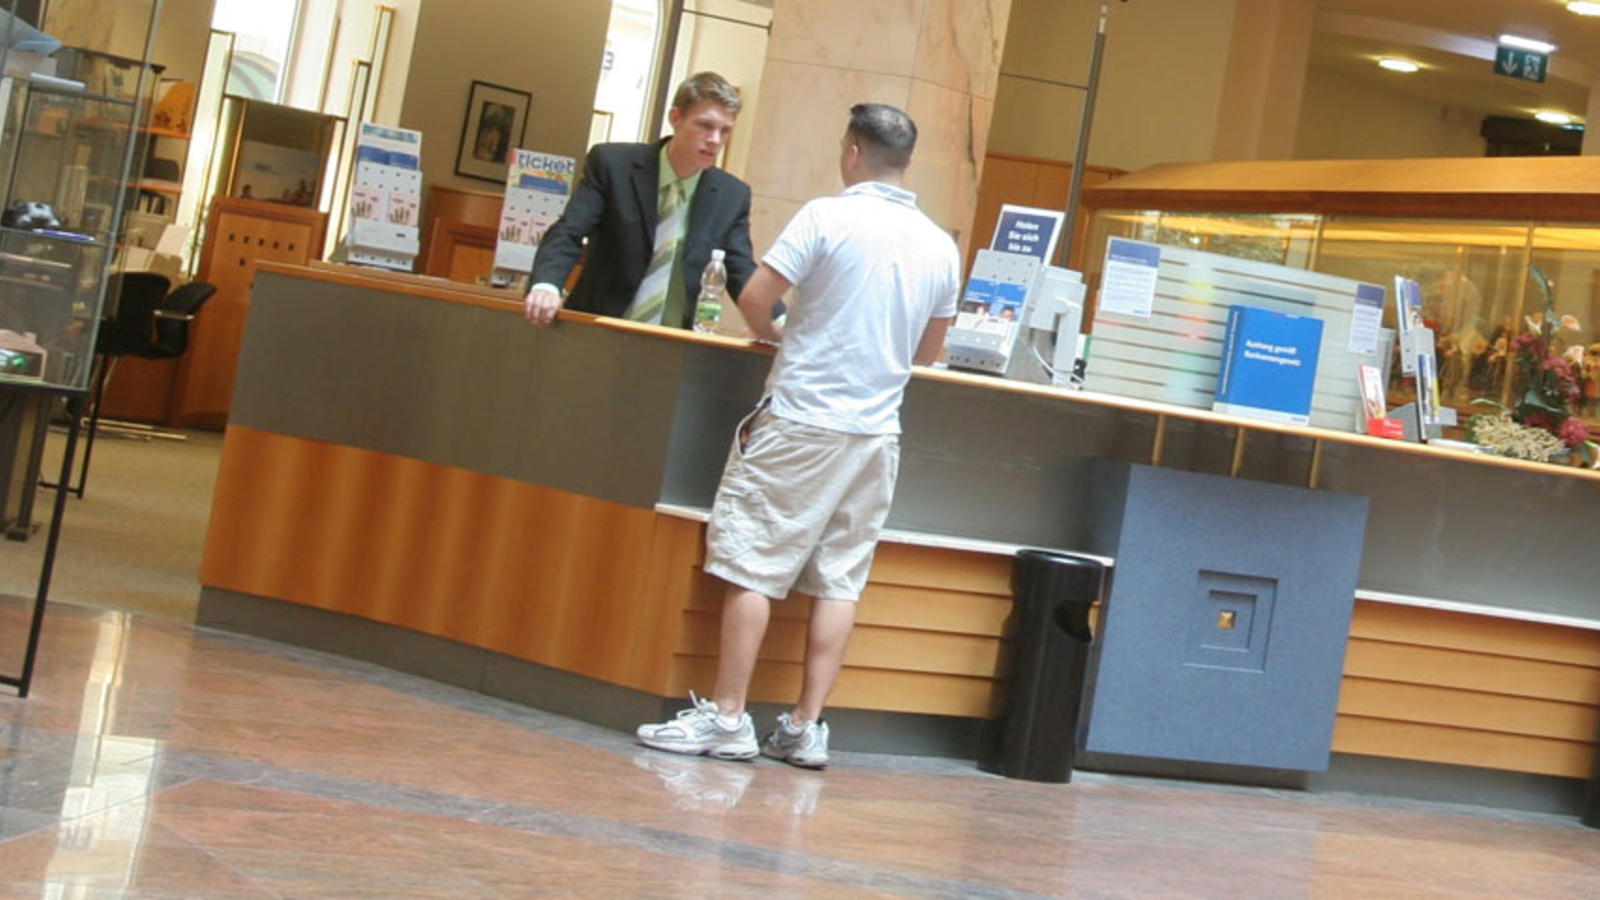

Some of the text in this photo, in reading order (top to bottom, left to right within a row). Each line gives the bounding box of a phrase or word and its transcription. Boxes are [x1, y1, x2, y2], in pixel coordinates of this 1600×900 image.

[518, 151, 576, 175] ticket
[1008, 230, 1040, 242] Sie sich
